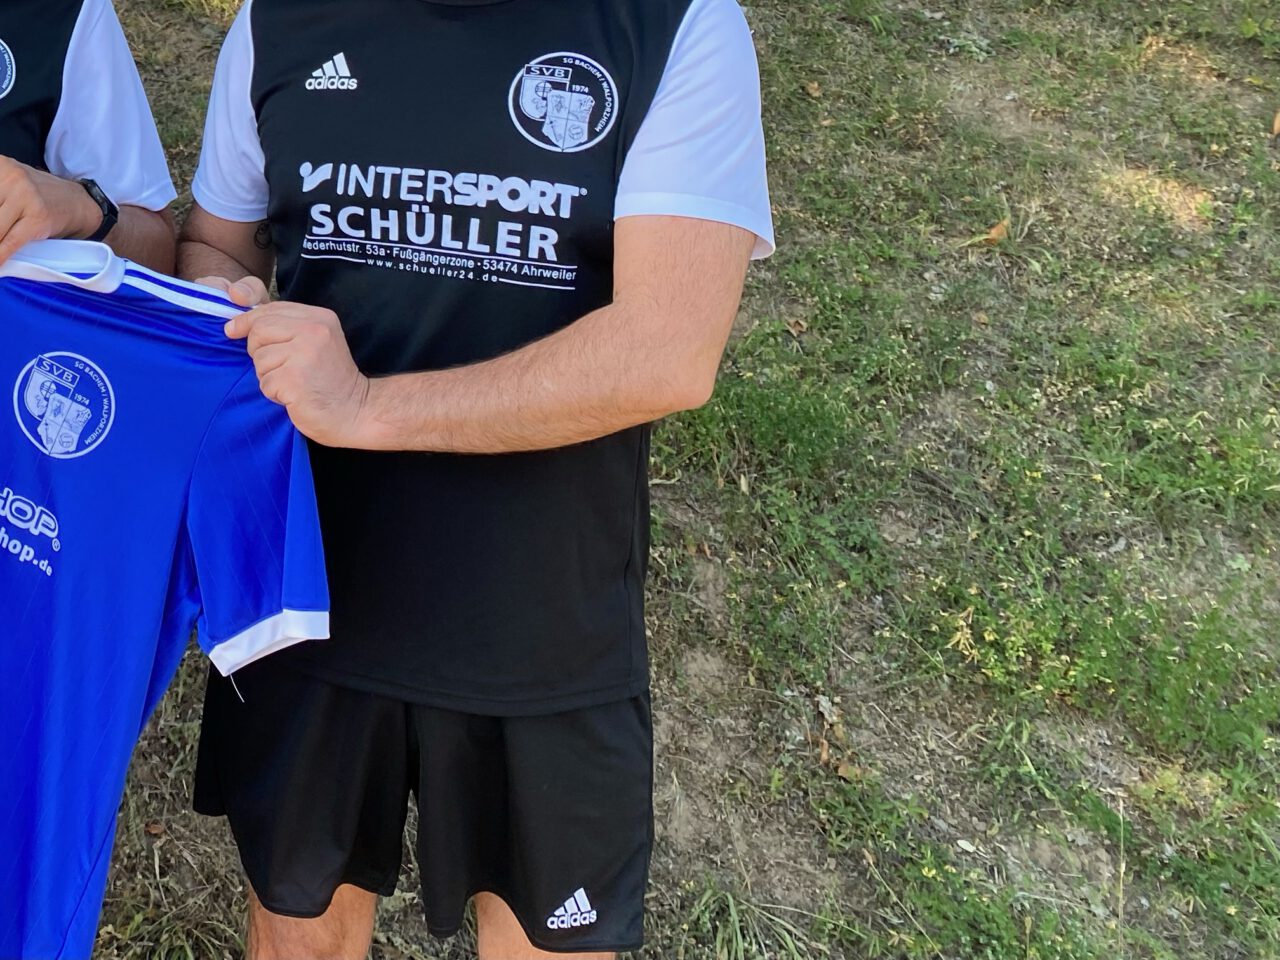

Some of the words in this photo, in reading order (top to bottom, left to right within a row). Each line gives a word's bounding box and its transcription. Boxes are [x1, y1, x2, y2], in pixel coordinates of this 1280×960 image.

[529, 66, 566, 78] SVB
[305, 75, 358, 90] adidas
[571, 84, 589, 93] 1974
[336, 163, 580, 219] INTERSPORT
[310, 203, 560, 261] SCHÜLLER
[392, 247, 475, 269] Fußgängerzone
[482, 259, 518, 275] 53474
[521, 264, 577, 281] Ahrweiler
[39, 360, 74, 383] SVB
[73, 392, 91, 406] 1974
[547, 910, 598, 929] adidas
